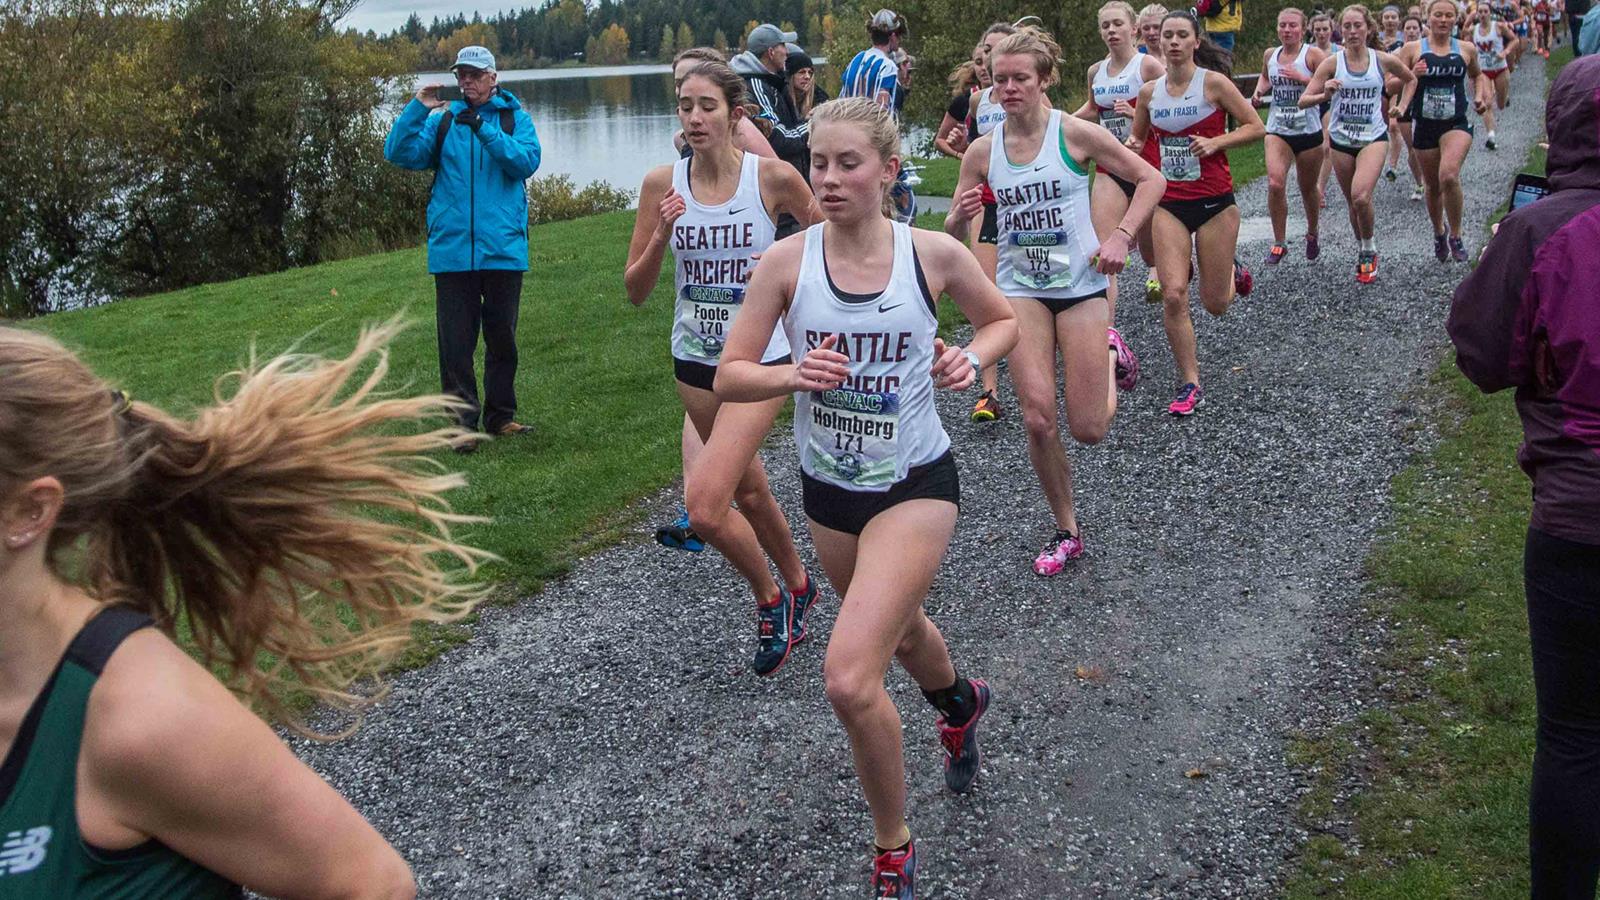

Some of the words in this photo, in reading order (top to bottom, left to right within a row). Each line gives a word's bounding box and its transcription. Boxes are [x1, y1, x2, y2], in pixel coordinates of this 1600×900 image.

[1107, 84, 1130, 94] FRASER
[1273, 89, 1302, 101] PACIFIC
[1340, 86, 1377, 99] SEATTLE
[1173, 105, 1198, 117] FRASER
[1339, 103, 1374, 115] PACIFIC
[997, 180, 1062, 206] SEATTLE
[1005, 207, 1064, 231] PACIFIC
[675, 223, 753, 251] SEATTLE
[1026, 248, 1050, 261] Lilly
[683, 259, 748, 285] PACIFIC
[1030, 260, 1051, 271] 173
[694, 304, 729, 322] Foote
[700, 322, 723, 336] 170
[812, 405, 894, 440] Holmberg
[834, 432, 864, 454] 171
